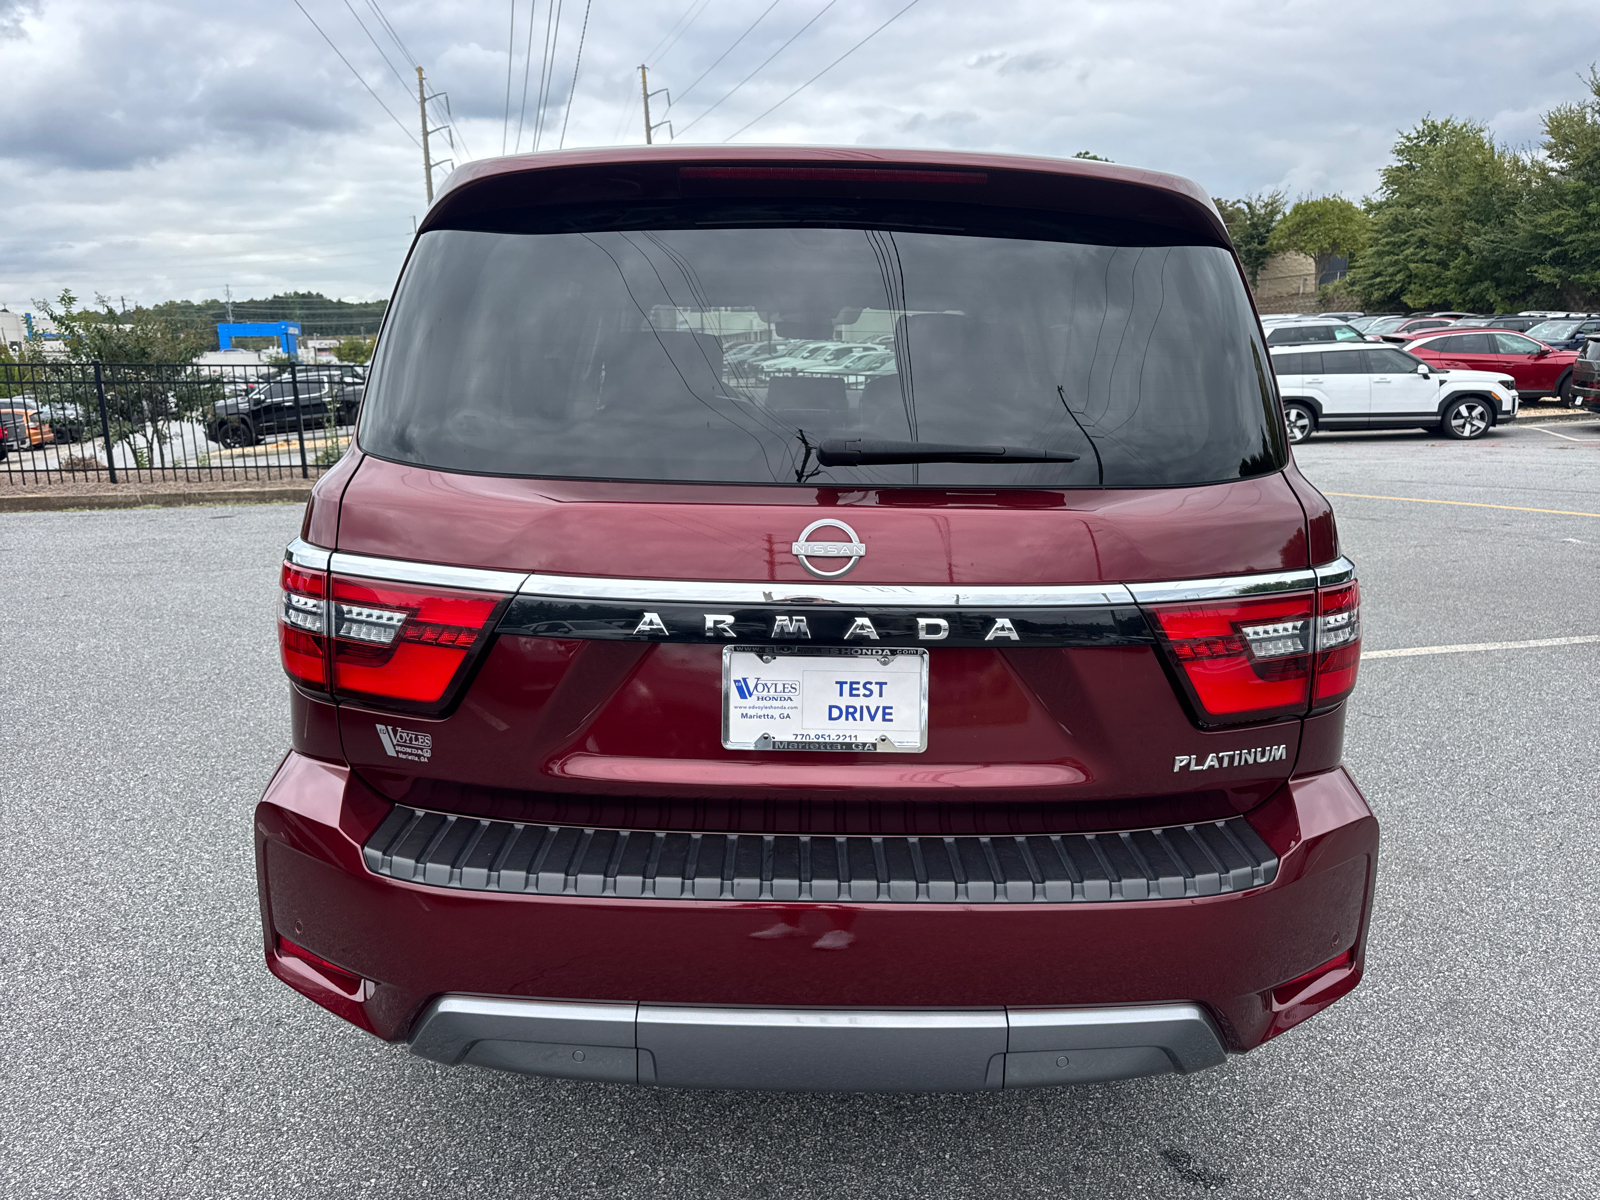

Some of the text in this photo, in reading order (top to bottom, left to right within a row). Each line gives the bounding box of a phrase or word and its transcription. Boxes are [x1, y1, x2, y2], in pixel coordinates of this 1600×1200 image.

[794, 545, 864, 555] NISSAN
[632, 612, 1021, 642] ARMADA
[741, 677, 798, 698] VOYLES
[834, 681, 888, 698] TEST
[740, 712, 791, 720] Marietta, GA
[827, 705, 894, 722] DRIVE
[387, 725, 431, 747] VOYLES
[792, 733, 859, 741] 770-951-2211
[395, 745, 424, 755] HONDA
[774, 741, 875, 751] Marietta, GA
[1173, 744, 1287, 773] PLATINUM
